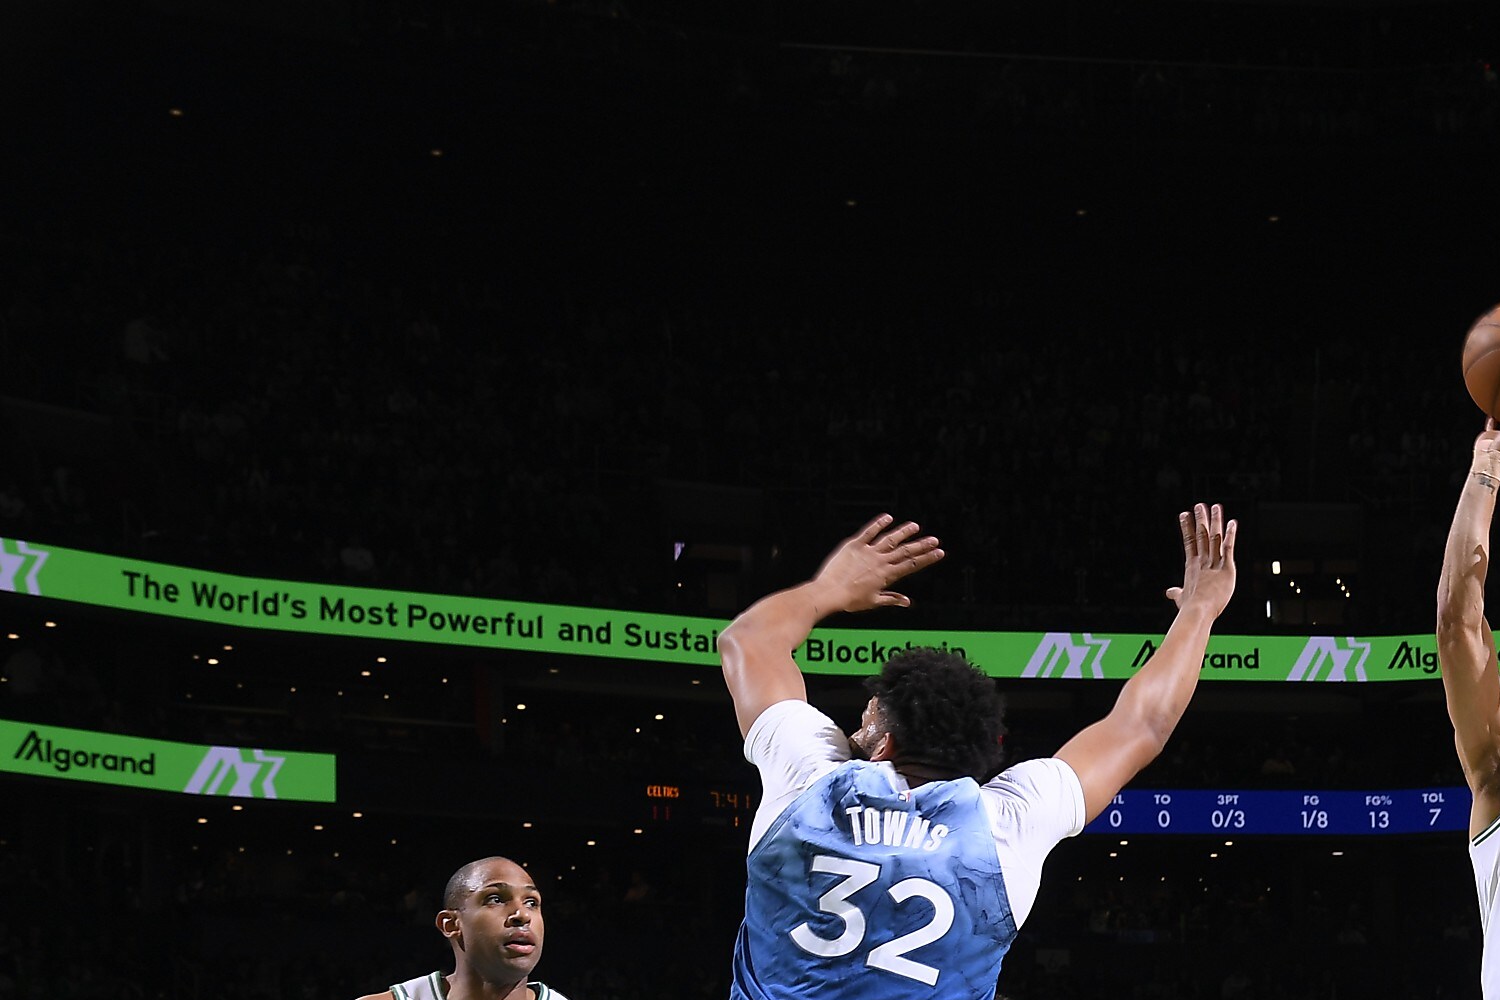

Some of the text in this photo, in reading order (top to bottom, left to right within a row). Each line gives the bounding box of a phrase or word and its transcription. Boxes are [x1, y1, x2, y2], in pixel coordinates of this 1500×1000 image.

[122, 570, 179, 603] The
[191, 581, 307, 619] World's
[320, 596, 398, 627] Most
[407, 604, 543, 639] Powerful
[558, 621, 612, 645] and
[14, 730, 155, 776] Algorand
[646, 784, 680, 798] CELTICS
[1153, 794, 1171, 805] TO
[1217, 794, 1239, 806] 3PT
[1303, 795, 1320, 806] FG
[1365, 795, 1393, 806] FG%
[1421, 792, 1445, 805] TOL
[845, 806, 950, 850] TOWNS
[1109, 808, 1442, 829] 0 0 0/3 1/8 13 7
[788, 854, 956, 987] 32
